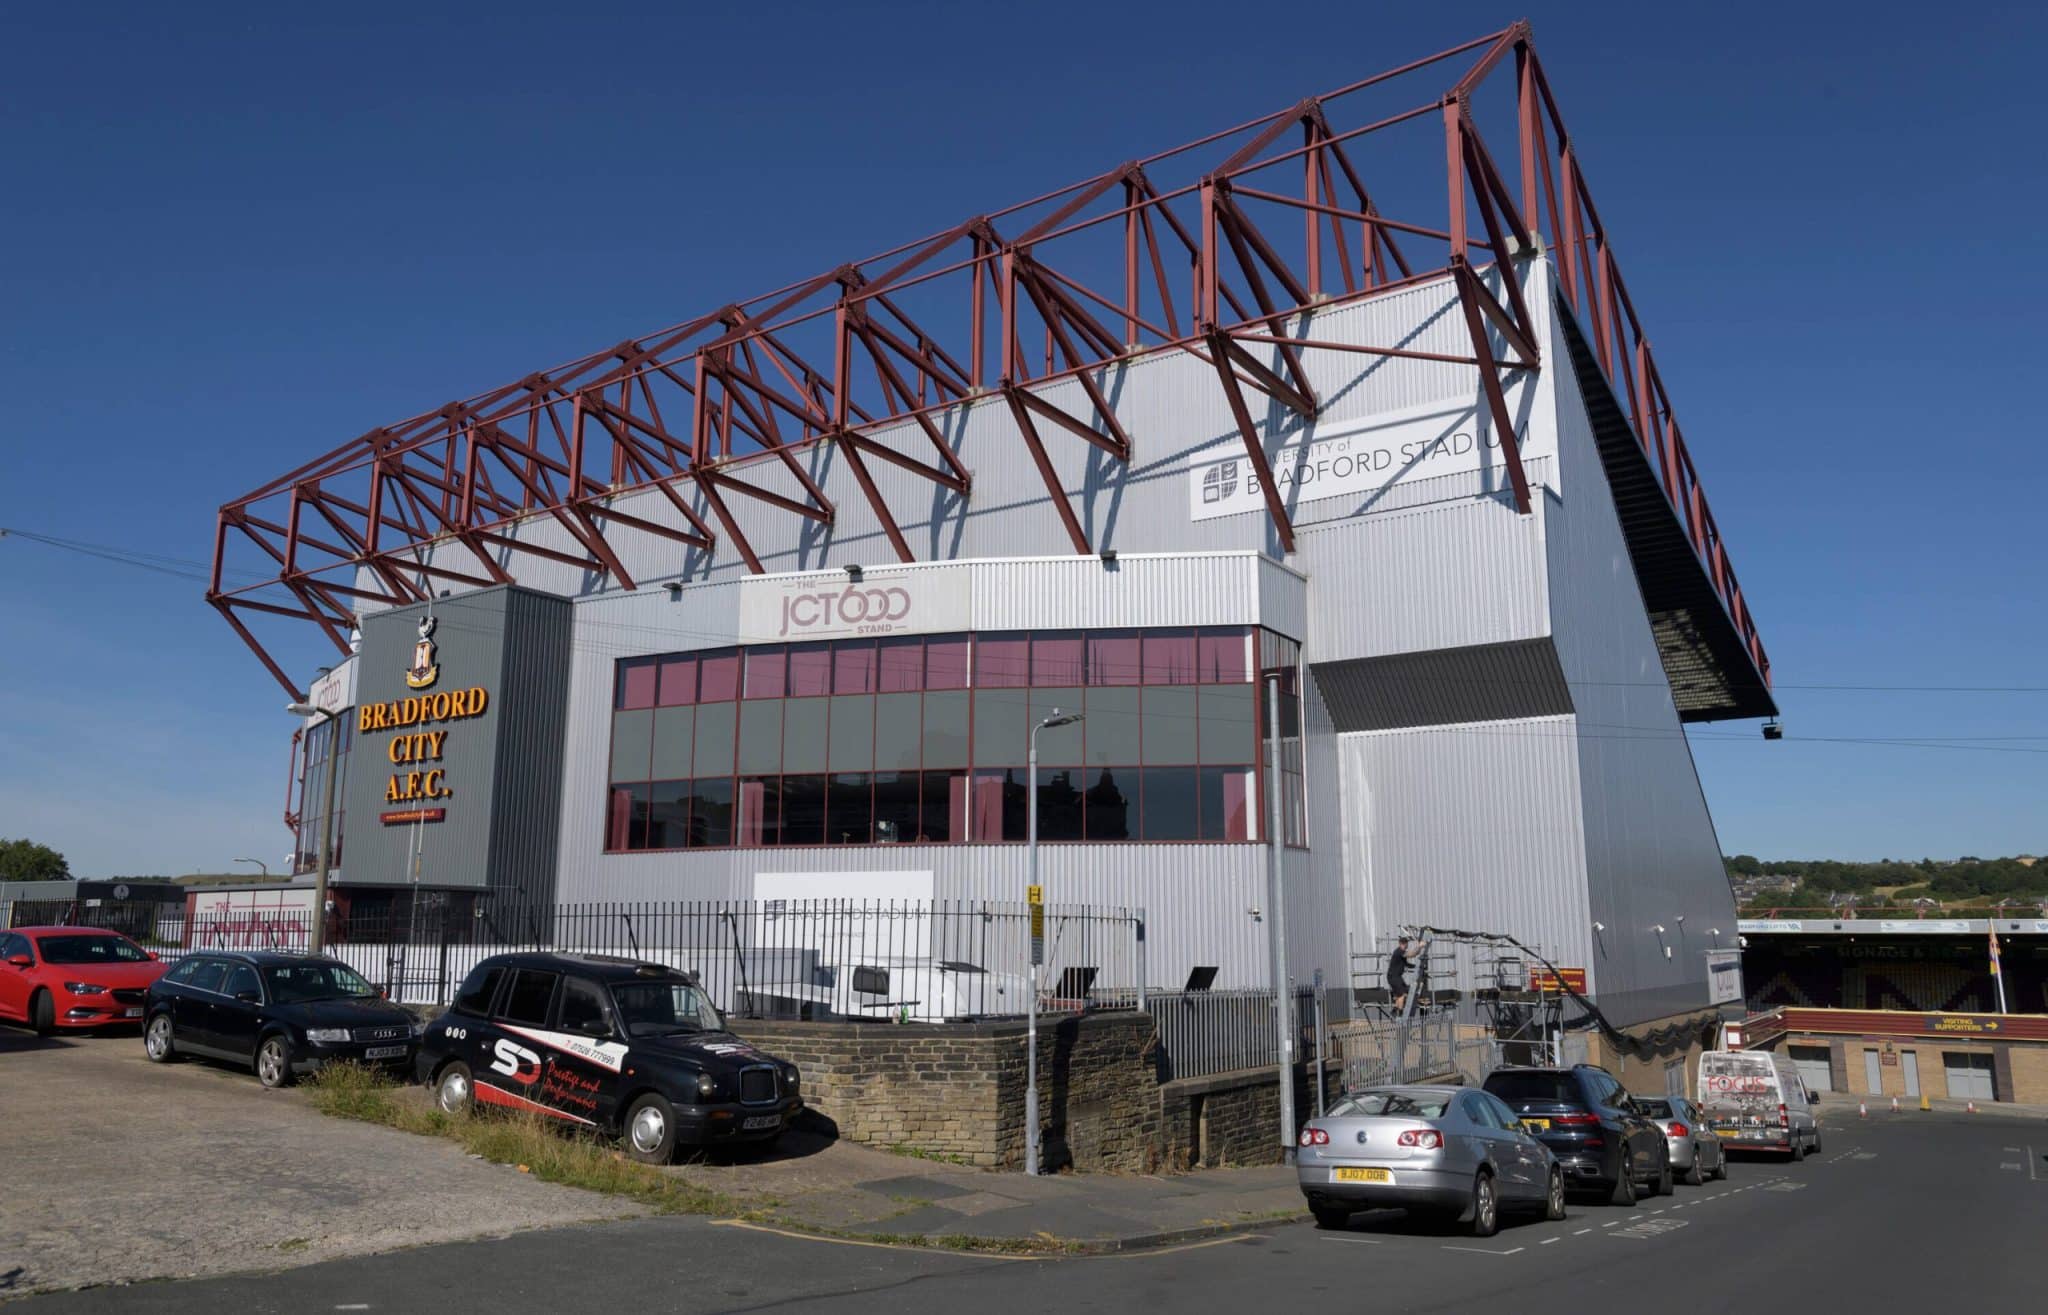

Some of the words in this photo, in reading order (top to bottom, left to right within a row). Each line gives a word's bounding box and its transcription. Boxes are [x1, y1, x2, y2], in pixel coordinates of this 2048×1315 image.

[1246, 441, 1334, 470] UIVERSITY
[1246, 448, 1392, 496] BADFORD
[796, 580, 817, 589] THE
[857, 623, 893, 634] STAND
[359, 687, 488, 732] BRADFORD
[388, 730, 447, 764] CITY
[384, 769, 453, 802] A.F.C.
[215, 902, 231, 913] THE
[1934, 1023, 1983, 1032] SUPPORTERS
[580, 1079, 601, 1093] and
[1708, 1075, 1767, 1093] FOCUS
